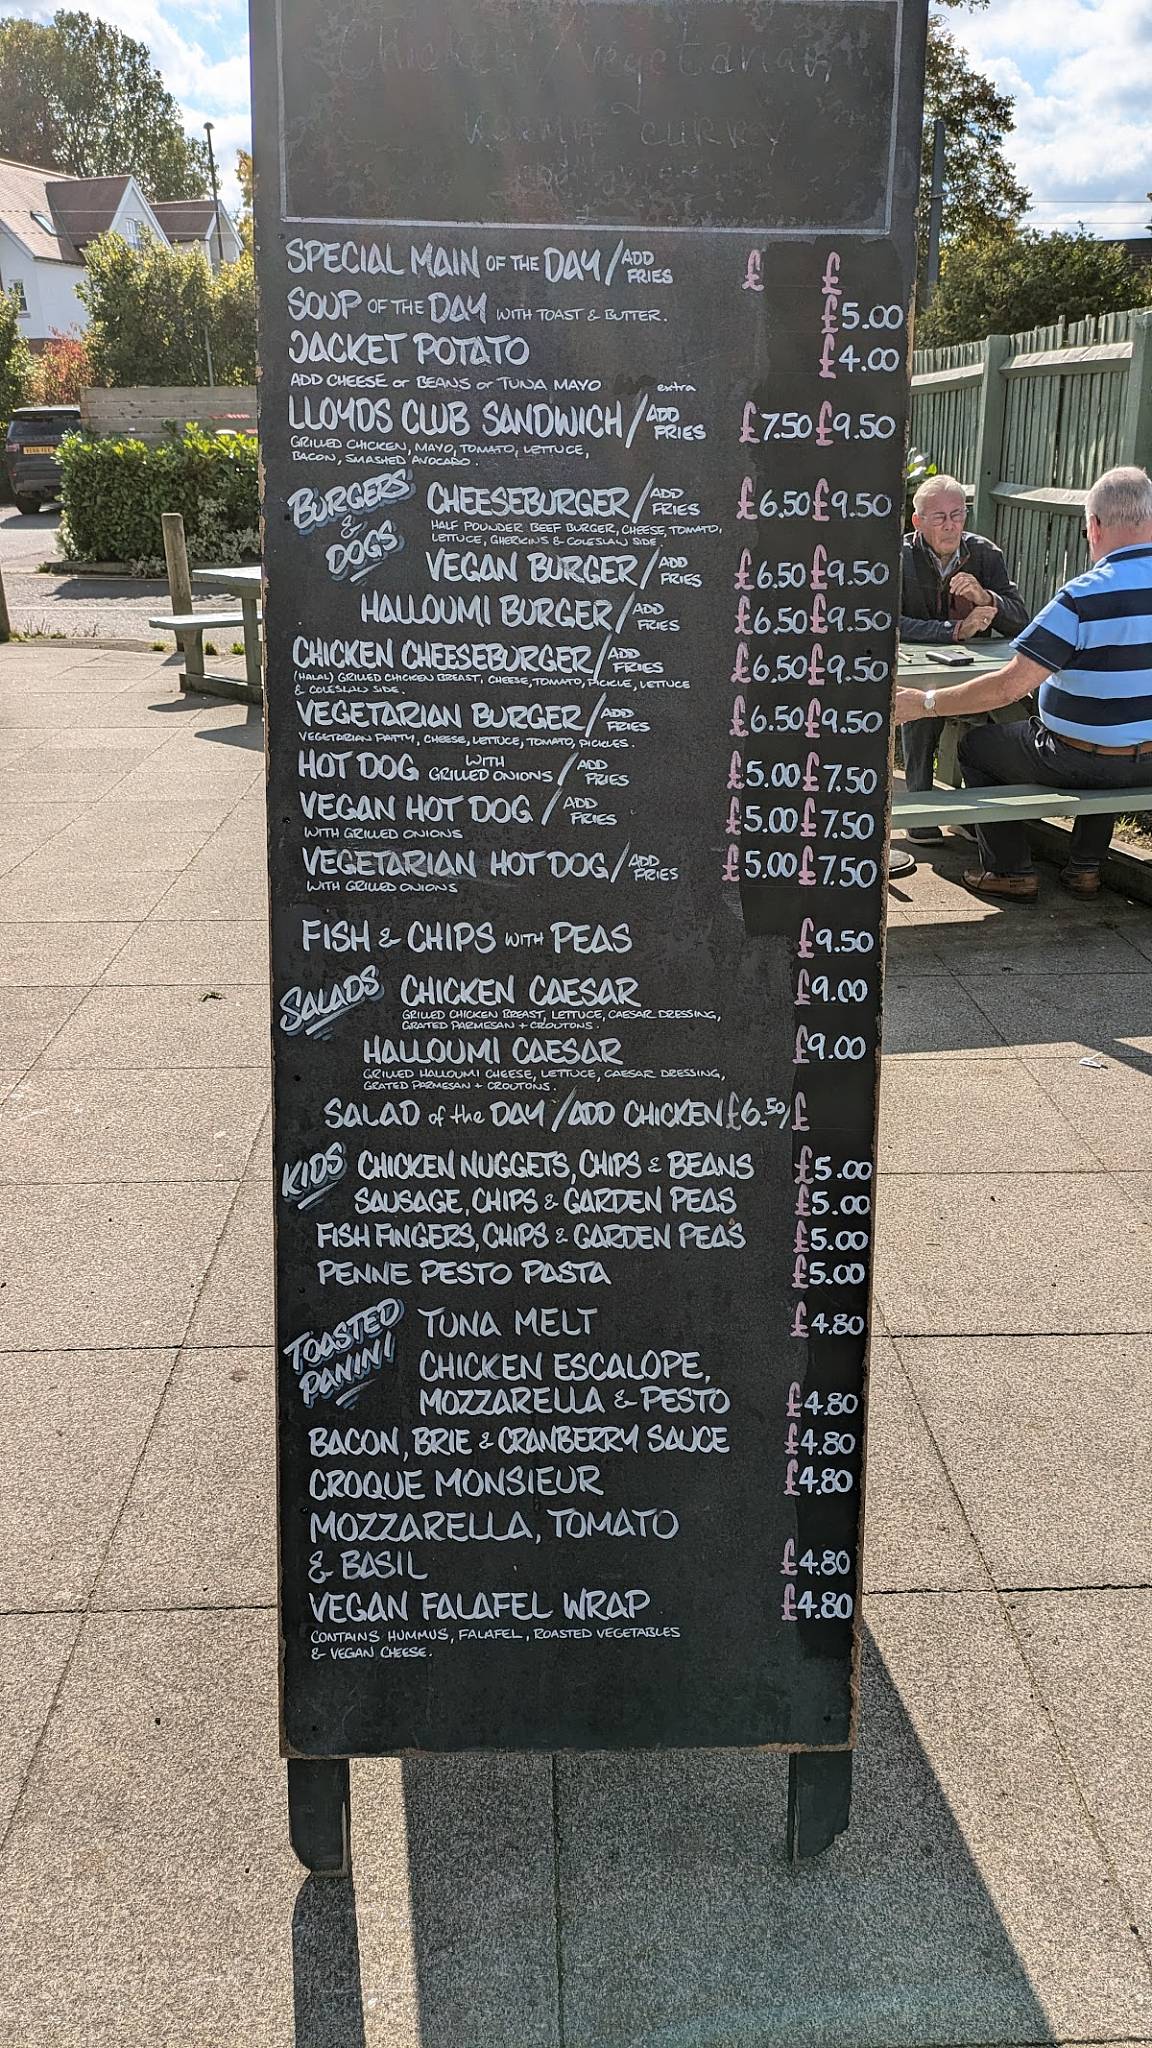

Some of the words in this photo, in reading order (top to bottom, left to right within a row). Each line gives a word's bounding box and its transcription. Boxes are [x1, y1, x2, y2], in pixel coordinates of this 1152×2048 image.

[286, 238, 404, 275] SPECIAL
[411, 242, 480, 278] MAIN
[486, 255, 506, 271] OF
[510, 255, 539, 271] THE
[621, 249, 654, 265] ADD
[627, 269, 673, 283] FRIES
[287, 287, 362, 320] SOUP
[368, 299, 388, 313] OF
[391, 299, 424, 315] THE
[428, 292, 487, 323] DAY
[497, 308, 532, 320] WITH
[536, 309, 584, 321] TOAST
[821, 293, 903, 334] £5.00
[289, 330, 407, 365] JACKET
[413, 333, 529, 366] POTATO
[819, 333, 899, 379] £4.00
[291, 373, 323, 386] ADD
[326, 374, 388, 388] CHEESE
[416, 376, 471, 391] BEANS
[476, 381, 493, 390] or
[496, 377, 548, 390] TUNA
[554, 379, 601, 391] MAYO
[657, 381, 696, 391] extra
[289, 395, 393, 433] LLOYDS
[402, 399, 470, 436] CLUB
[646, 405, 679, 423] ADD
[654, 424, 706, 440] FRIES
[739, 401, 812, 443] £7.50
[816, 401, 896, 446] £9.50
[291, 435, 342, 448] GRILLED
[287, 469, 411, 531] BURGERS
[736, 477, 810, 520] £6.50
[812, 478, 892, 521] £9.50
[326, 518, 397, 577] DOGS
[425, 548, 518, 582] VEGAN
[658, 557, 688, 568] ADD
[661, 573, 702, 587] FRIES
[734, 548, 806, 590] £6.50
[810, 544, 889, 590] £9.50
[361, 590, 491, 627] HALLOUMI
[735, 595, 807, 635] £6.50
[810, 593, 891, 634] £9.50
[293, 636, 394, 670] CHICKEN
[731, 642, 807, 683] £6.50
[808, 643, 888, 685] £9.50
[296, 699, 462, 728] VEGETARIAN
[729, 695, 804, 737] £6.50
[804, 698, 883, 738] £9.50
[299, 749, 353, 779] HOT
[356, 752, 419, 781] DOG
[429, 767, 489, 781] GRILLED
[493, 771, 553, 782] ONIONS
[577, 760, 608, 770] ADD
[466, 754, 504, 767] WITH
[727, 751, 801, 789] £5.00
[803, 752, 877, 794] £7.50
[585, 773, 629, 786] FRIES
[300, 791, 395, 821] VEGAN
[406, 794, 464, 822] HOT
[468, 795, 533, 823] DOG
[725, 796, 798, 835] £5.00
[800, 798, 874, 840] £7.50
[305, 827, 339, 838] WITH
[344, 828, 398, 839] GRILLED
[403, 829, 463, 839] ONIONS
[302, 846, 477, 879] VEGETARIAN
[491, 849, 546, 876] HOT
[628, 854, 660, 869] ADD
[634, 867, 678, 881] FRIES
[722, 844, 797, 881] £5.00
[798, 845, 877, 888] £7.50
[302, 920, 370, 952] FISH
[408, 921, 496, 953] CHIPS
[505, 932, 544, 947] WITH
[550, 922, 632, 954] PEAS
[797, 918, 874, 958] £9.50
[280, 965, 381, 1034] SALADS
[401, 974, 514, 1006] CHICKEN
[529, 975, 641, 1007] CAESAR
[794, 969, 868, 1005] £9.00
[364, 1035, 500, 1064] HALLOUMI
[512, 1037, 623, 1065] CAESAR
[792, 1025, 866, 1064] £9.00
[324, 1098, 420, 1128] SALAD
[428, 1108, 446, 1127] of
[450, 1104, 485, 1124] the
[490, 1100, 545, 1127] DAY
[624, 1099, 723, 1127] CHICKEN
[282, 1142, 346, 1199] KIDS
[358, 1149, 455, 1180] CHICKEN
[461, 1150, 576, 1185] NUGGETS,
[579, 1149, 642, 1178] CHIPS
[667, 1151, 754, 1179] BEANS
[794, 1146, 872, 1184] £5.00
[354, 1187, 469, 1216] SAUSAGE,
[472, 1187, 538, 1214] CHIPS
[564, 1186, 662, 1214] GARDEN
[670, 1186, 737, 1214] PEAS
[795, 1184, 869, 1216] £5.00
[316, 1222, 370, 1248] FISH
[375, 1222, 479, 1252] FINGERS,
[482, 1222, 549, 1248] CHIPS
[574, 1223, 671, 1249] GARDEN
[679, 1220, 746, 1249] PEAS
[793, 1220, 868, 1253] £5.00
[317, 1260, 412, 1286] PENNE
[420, 1260, 512, 1285] PESTO
[521, 1260, 611, 1284] PASTA
[792, 1254, 865, 1288] £5.00
[284, 1298, 402, 1372] TOASTED
[417, 1307, 501, 1338] TUNA
[515, 1307, 597, 1336] MELT
[790, 1301, 864, 1338] £4.80
[298, 1329, 394, 1406] PANINI
[420, 1350, 542, 1382] CHICKEN
[553, 1350, 710, 1384] ESCALOPE,
[420, 1386, 605, 1416] MOZZARELLA
[640, 1386, 730, 1413] PESTO
[786, 1382, 858, 1417] £4.80
[308, 1427, 408, 1462] BACON,
[412, 1427, 472, 1456] BRIE
[498, 1424, 639, 1454] CRANBERRY
[647, 1424, 730, 1453] SAUCE
[784, 1423, 855, 1455] £4.80
[309, 1469, 425, 1500] CROQUE
[436, 1465, 604, 1497] MONSIEUR
[784, 1459, 853, 1496] £4.80
[310, 1510, 541, 1544] MOZZARELLA,
[547, 1508, 679, 1539] TOMATO
[340, 1550, 428, 1579] BASIL
[780, 1538, 850, 1576] £4.80
[309, 1591, 408, 1623] VEGAN
[421, 1591, 553, 1620] FALAFEL
[564, 1588, 650, 1620] WRAP
[781, 1583, 852, 1621] £4.80
[311, 1630, 380, 1643] CONTAINS
[533, 1628, 592, 1639] ROASTED
[597, 1627, 680, 1638] VEGETABLES
[330, 1646, 374, 1659] VEGAN
